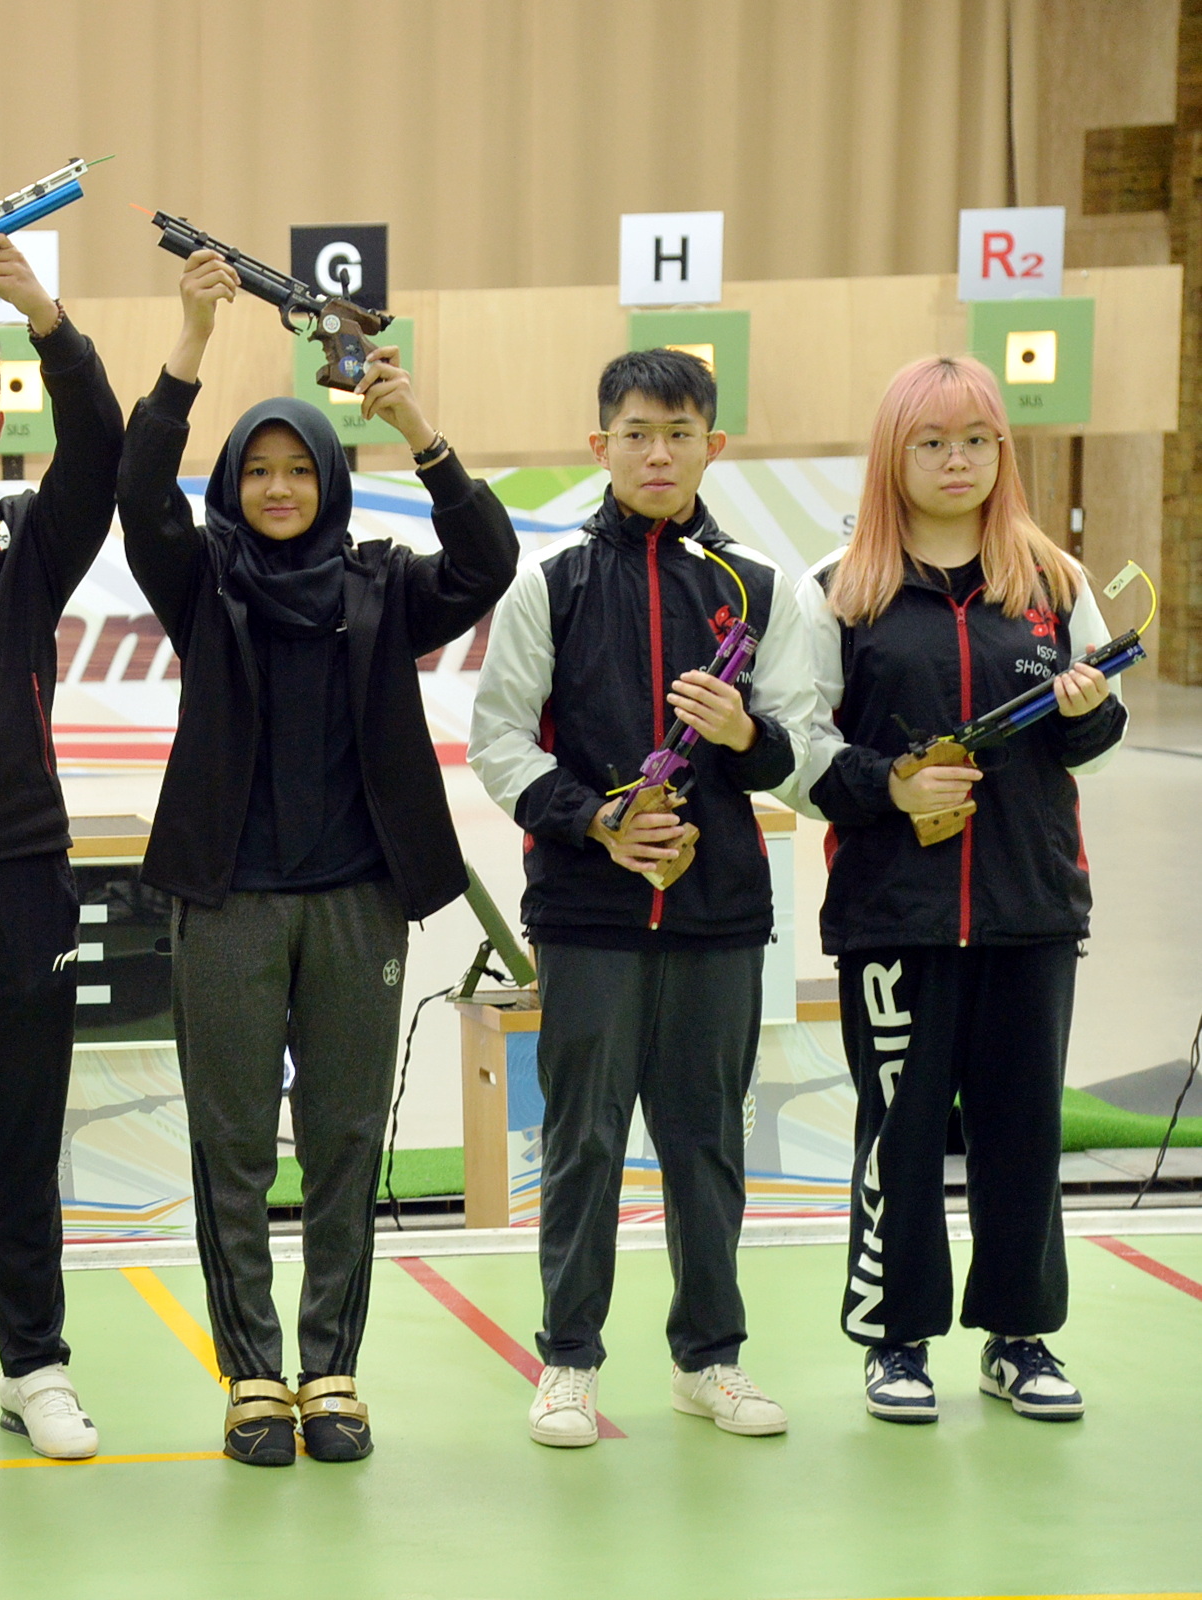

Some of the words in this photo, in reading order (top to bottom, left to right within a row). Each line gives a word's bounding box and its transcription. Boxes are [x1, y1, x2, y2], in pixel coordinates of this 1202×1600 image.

[314, 241, 363, 296] G
[653, 236, 690, 283] H
[981, 230, 1045, 279] R2
